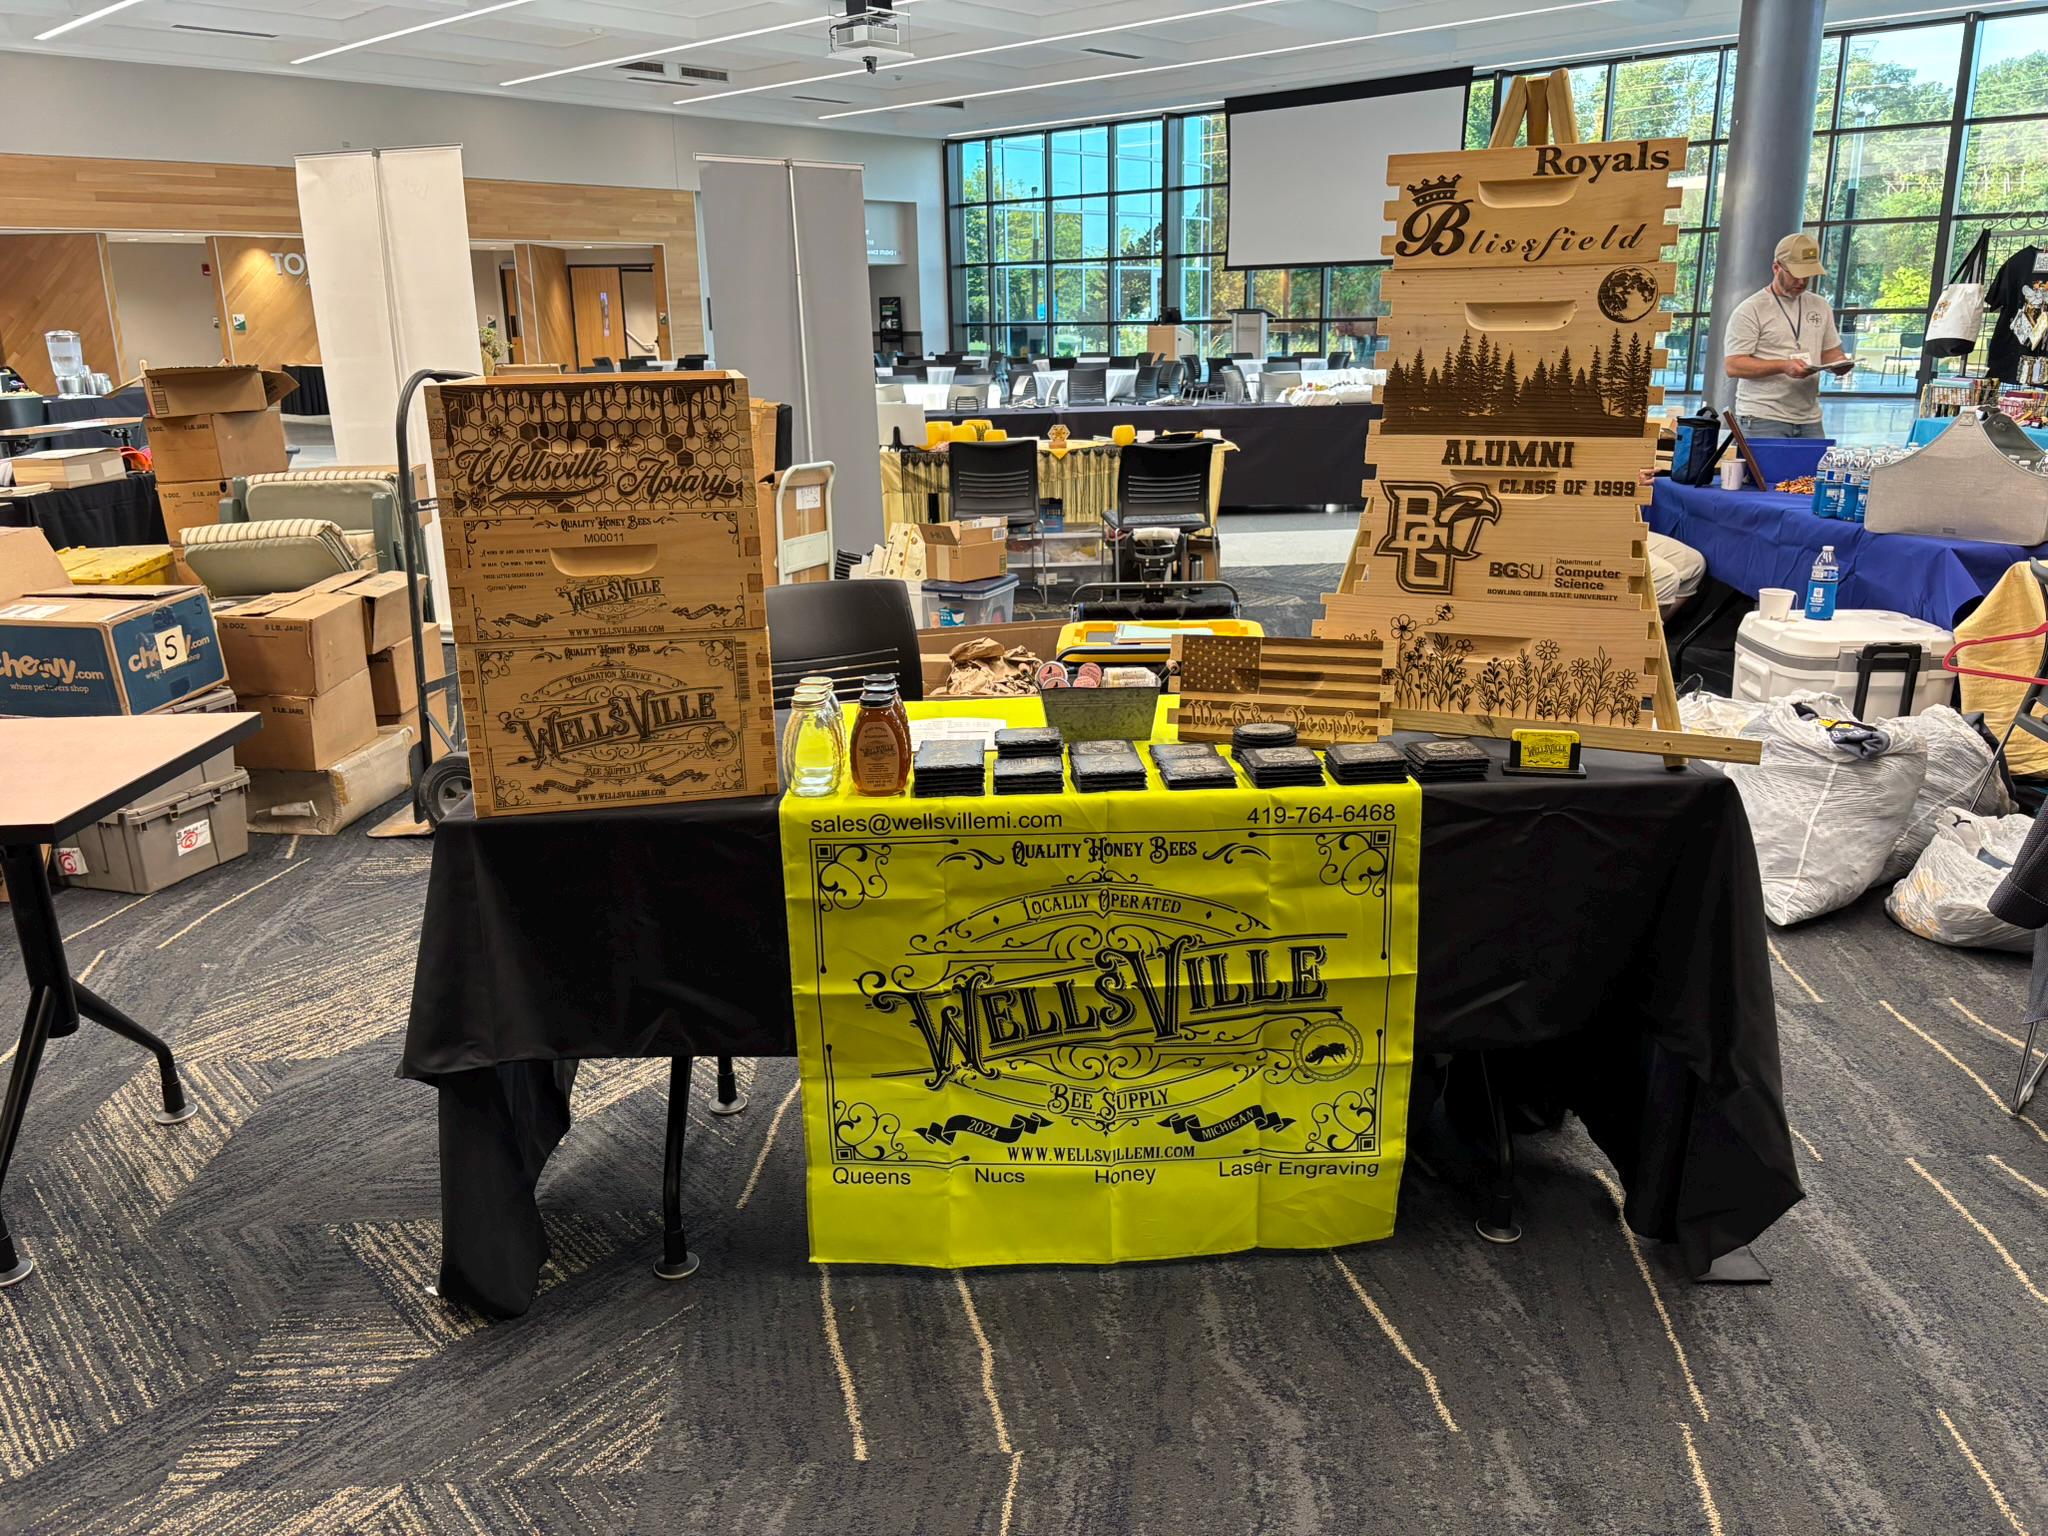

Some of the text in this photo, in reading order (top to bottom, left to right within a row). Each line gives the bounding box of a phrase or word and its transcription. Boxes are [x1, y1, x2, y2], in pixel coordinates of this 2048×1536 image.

[1533, 142, 1670, 183] Royals
[1395, 199, 1648, 262] Blissfield
[270, 252, 306, 275] TO
[1441, 439, 1575, 468] ALUMNI
[455, 444, 744, 500] Wellsville Apiary
[1498, 479, 1636, 497] CLASS OF 1999
[595, 516, 626, 530] HONEY
[627, 515, 651, 529] BEES
[584, 533, 624, 543] M00011
[1489, 561, 1544, 580] BGSU
[1555, 565, 1622, 580] Computer
[1556, 558, 1593, 567] Department
[1487, 588, 1618, 601] BOWLING GREEN STATE UNIVERSITY
[1554, 578, 1605, 591] Science
[597, 644, 626, 657] HONEY
[627, 643, 651, 656] BEES
[566, 668, 652, 687] POLLINATION SERVICE
[501, 690, 717, 769] WELLSVILLE
[1189, 701, 1227, 729] We
[1285, 706, 1370, 740] People
[811, 812, 1063, 836] sales@wellsvillemi.com
[1247, 803, 1396, 825] 419-764-6468
[1012, 836, 1197, 867] QUALITY HONEY BEES
[1021, 889, 1182, 922] LOCALLY OPERATED
[871, 934, 1328, 1090] WELLSVILLE
[1047, 1083, 1169, 1121] BEE SUPPLY
[966, 1118, 1000, 1139] 2024
[1202, 1108, 1255, 1140] MICHIGAN
[1007, 1145, 1195, 1162] WWW.WELLSVILLEMI.COM
[832, 1166, 912, 1186] Queens
[974, 1167, 1025, 1184] Nucs
[1095, 1166, 1156, 1185] Honey
[1219, 1161, 1379, 1178] Laser Engraving
